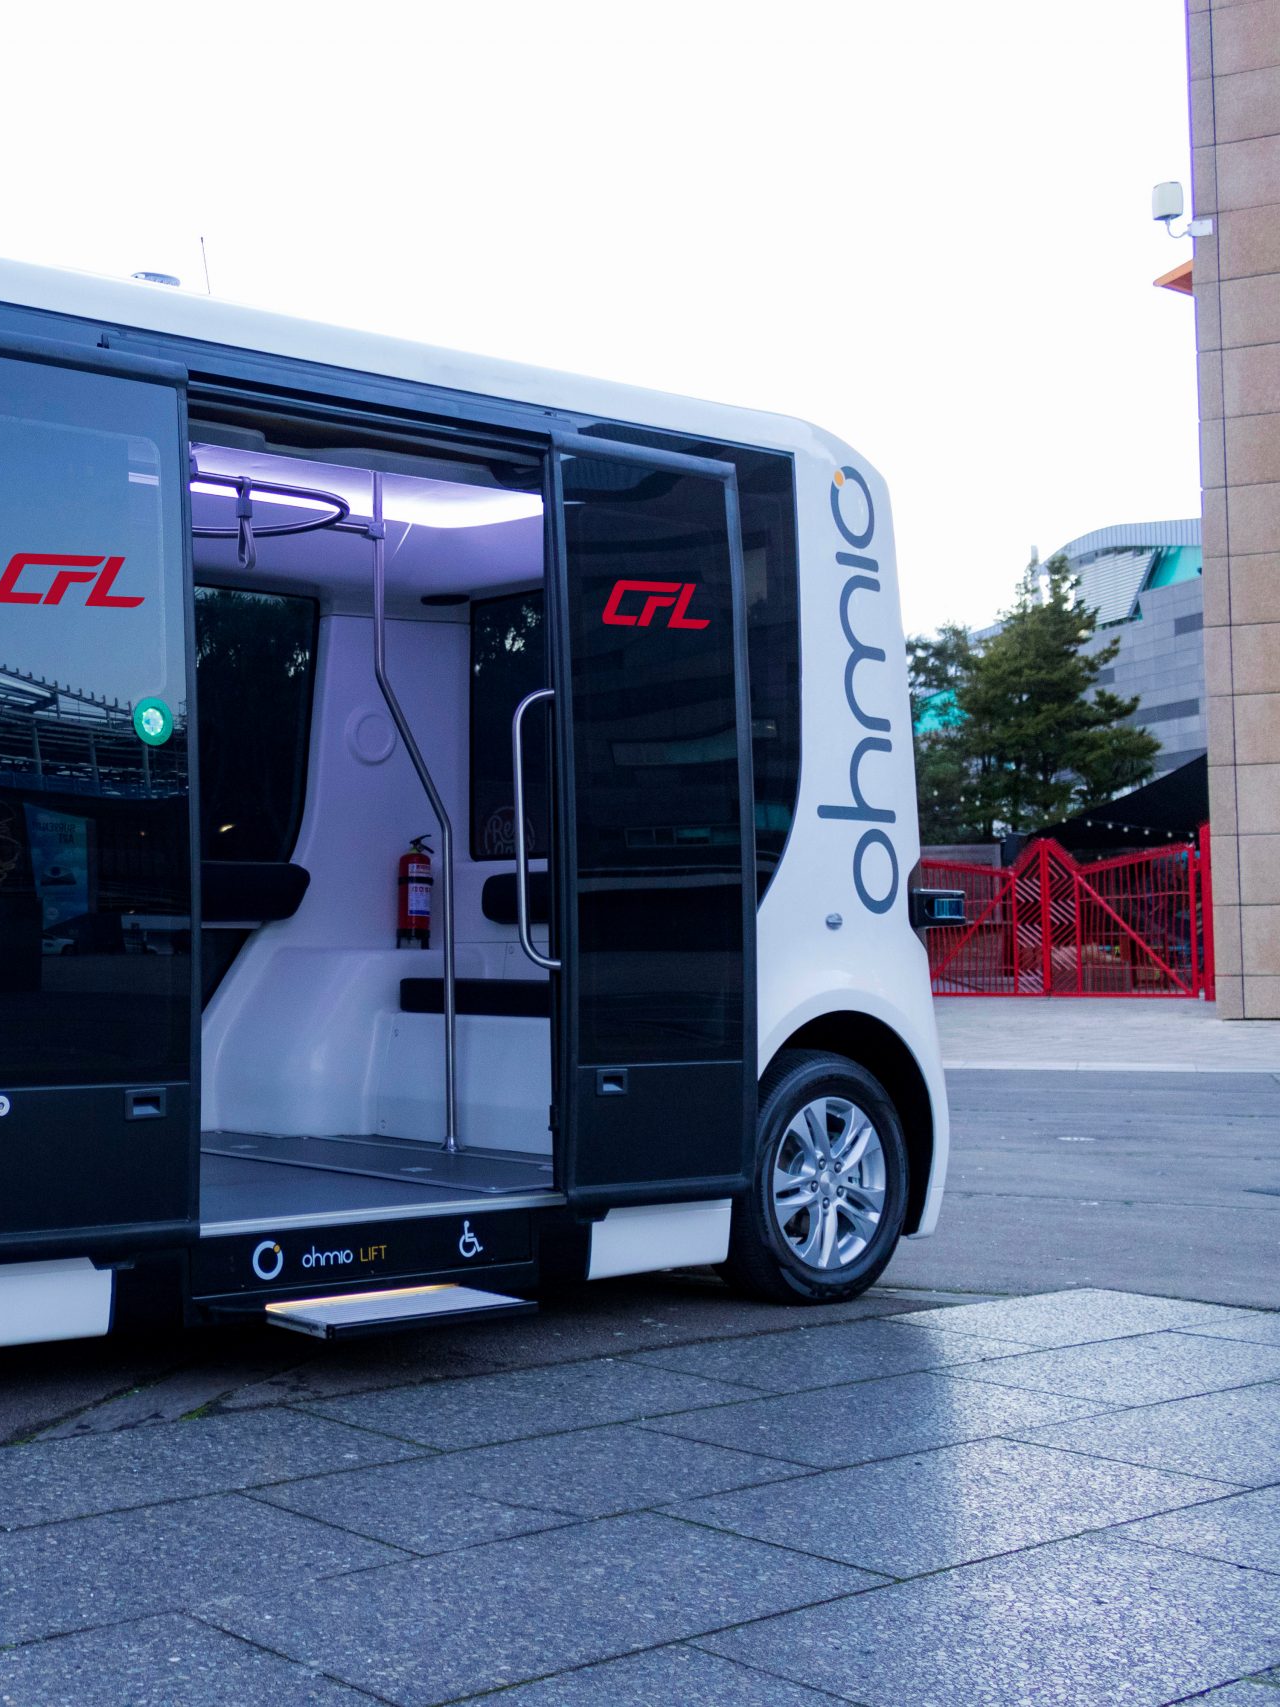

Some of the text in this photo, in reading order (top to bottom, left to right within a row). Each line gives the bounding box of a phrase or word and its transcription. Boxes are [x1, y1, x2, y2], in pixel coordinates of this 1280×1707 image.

[602, 579, 711, 629] CFL
[817, 465, 899, 914] ohmio
[302, 1245, 388, 1268] ohmio LIFT
